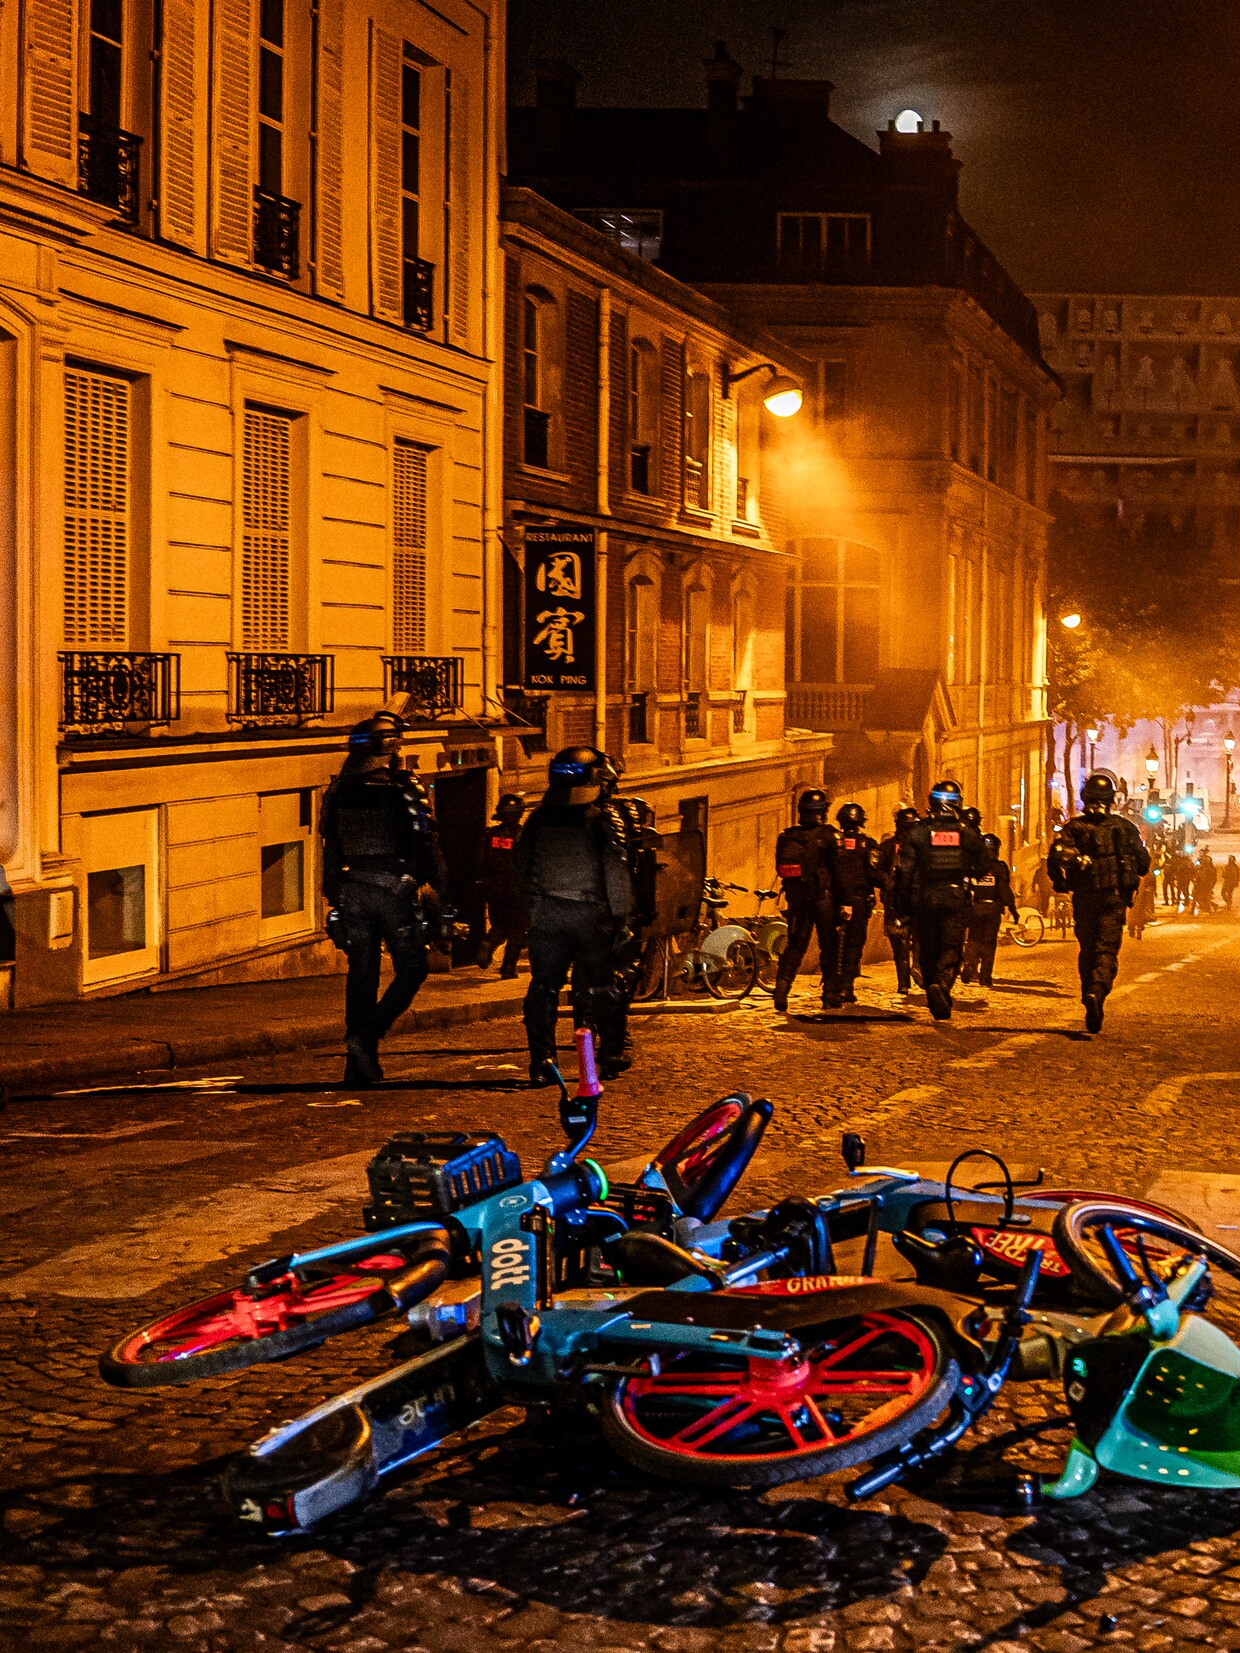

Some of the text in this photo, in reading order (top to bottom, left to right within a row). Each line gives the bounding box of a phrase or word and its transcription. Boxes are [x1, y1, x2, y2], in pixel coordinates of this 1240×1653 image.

[525, 532, 593, 543] RESTAURANT
[531, 674, 588, 685] KOK PING
[490, 1238, 530, 1291] dott
